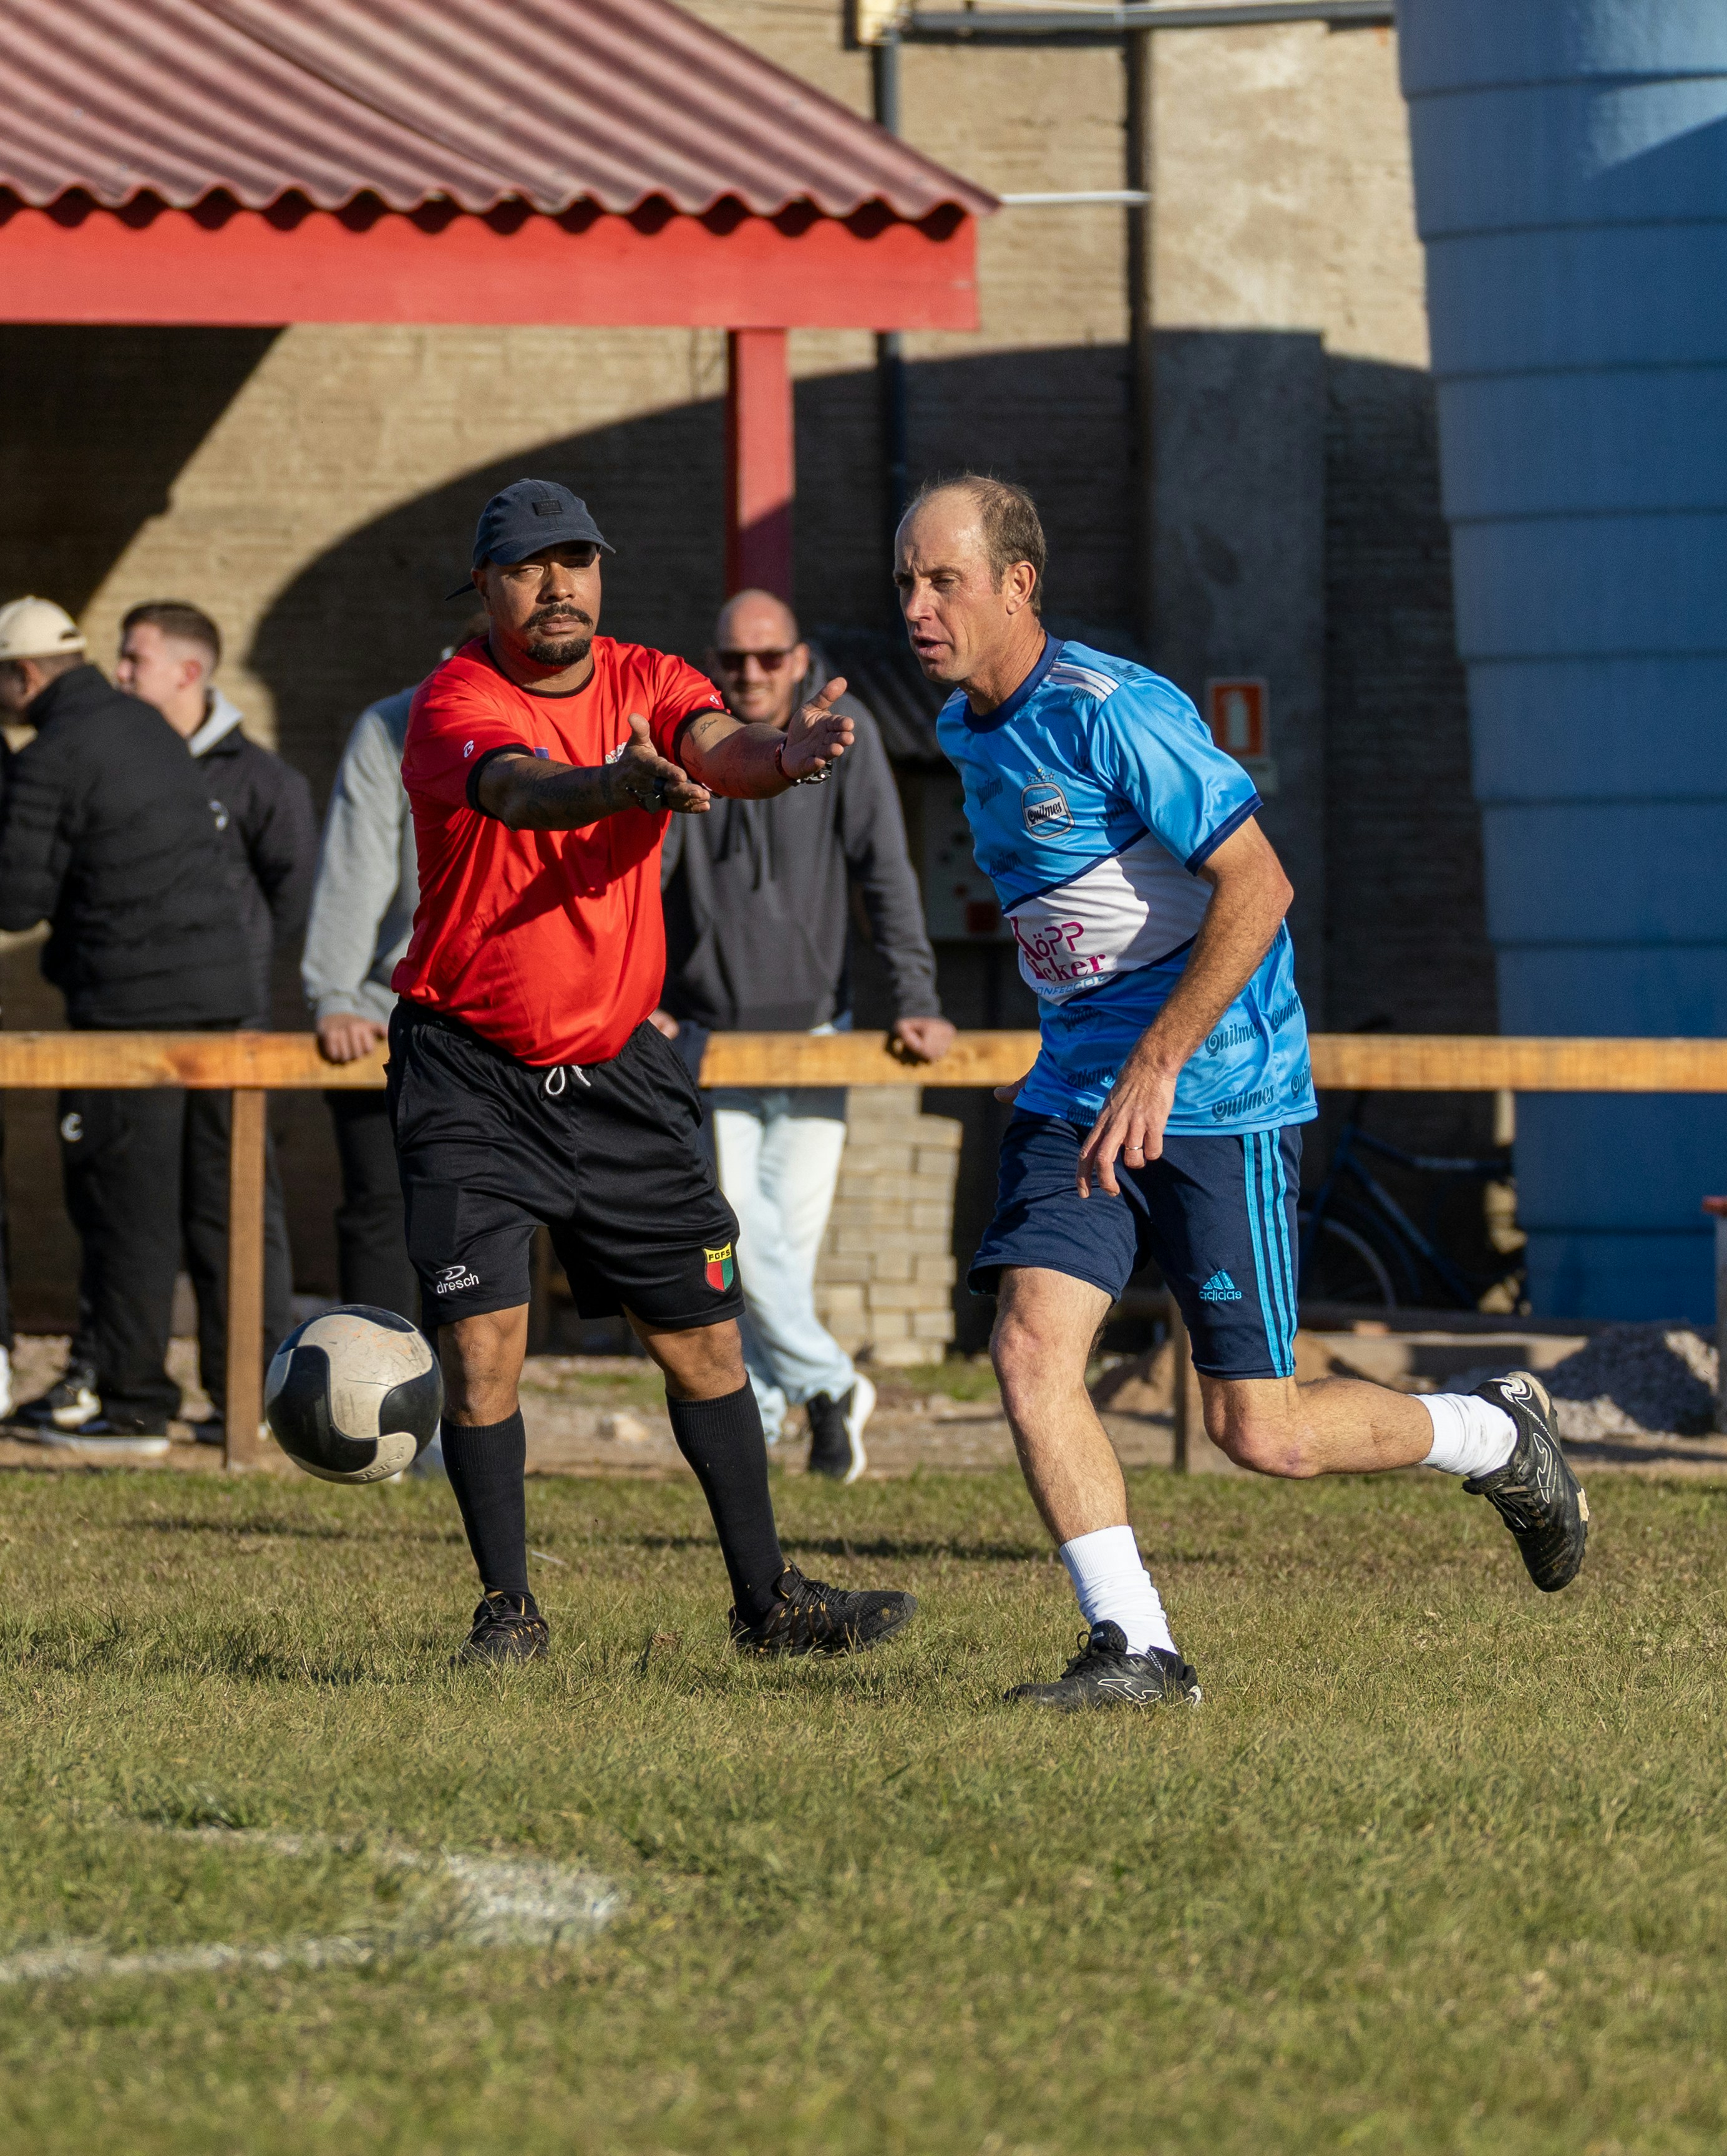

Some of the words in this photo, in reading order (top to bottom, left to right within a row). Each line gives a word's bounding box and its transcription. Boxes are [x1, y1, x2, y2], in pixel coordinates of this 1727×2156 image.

[1027, 801, 1063, 825] Quilmes
[1212, 1084, 1274, 1123] Quilmes
[708, 1249, 731, 1261] FGFS
[437, 1273, 480, 1294] dresch
[1199, 1289, 1242, 1302] adidas
